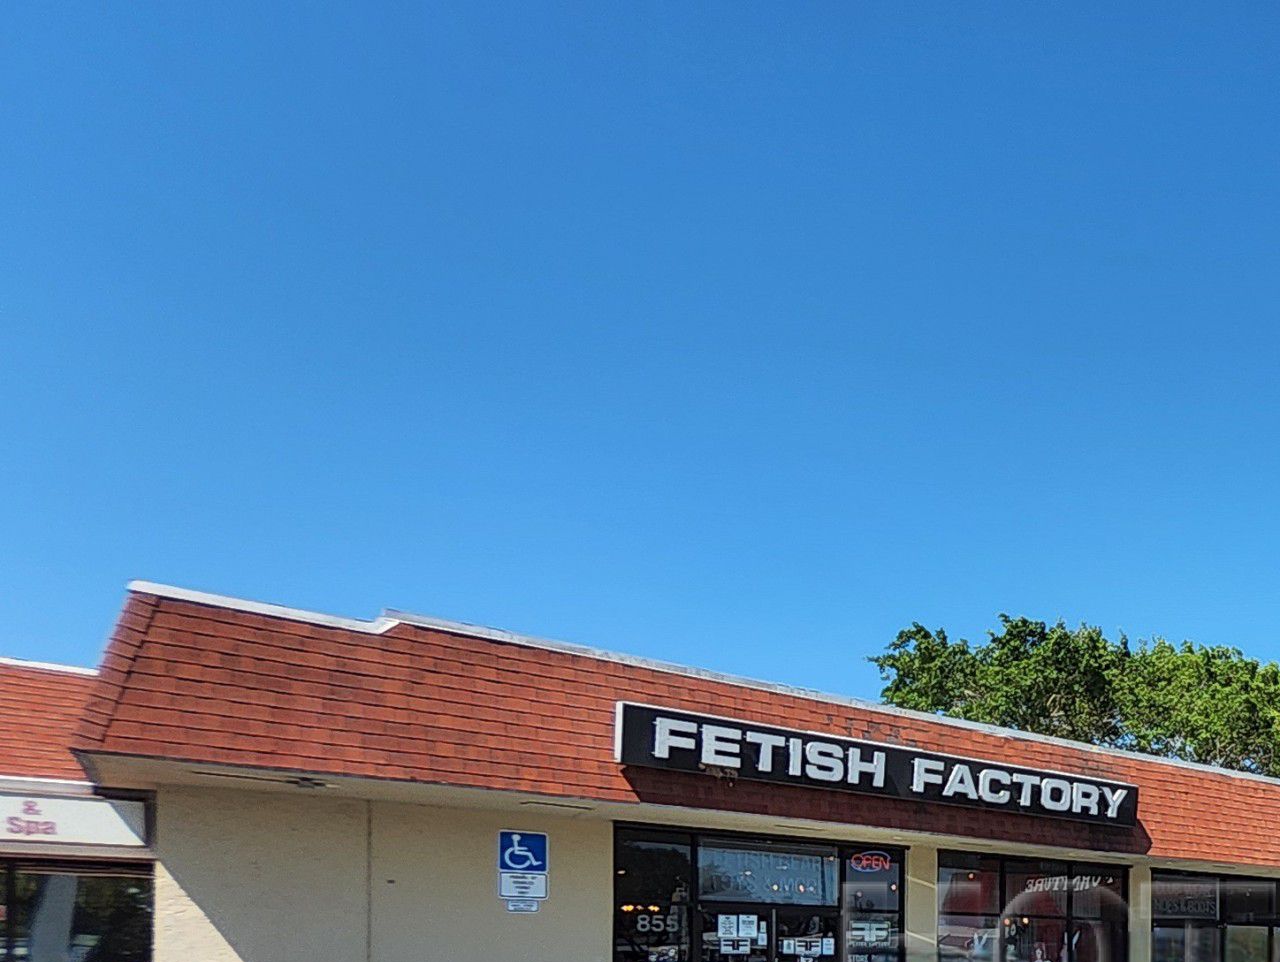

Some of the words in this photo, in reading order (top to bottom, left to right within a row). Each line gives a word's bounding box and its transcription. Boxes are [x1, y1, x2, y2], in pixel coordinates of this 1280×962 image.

[652, 716, 886, 788] FETISH
[911, 757, 1128, 819] FACTORY
[6, 816, 58, 836] Spa
[851, 853, 890, 871] OPEN
[636, 914, 679, 932] 855
